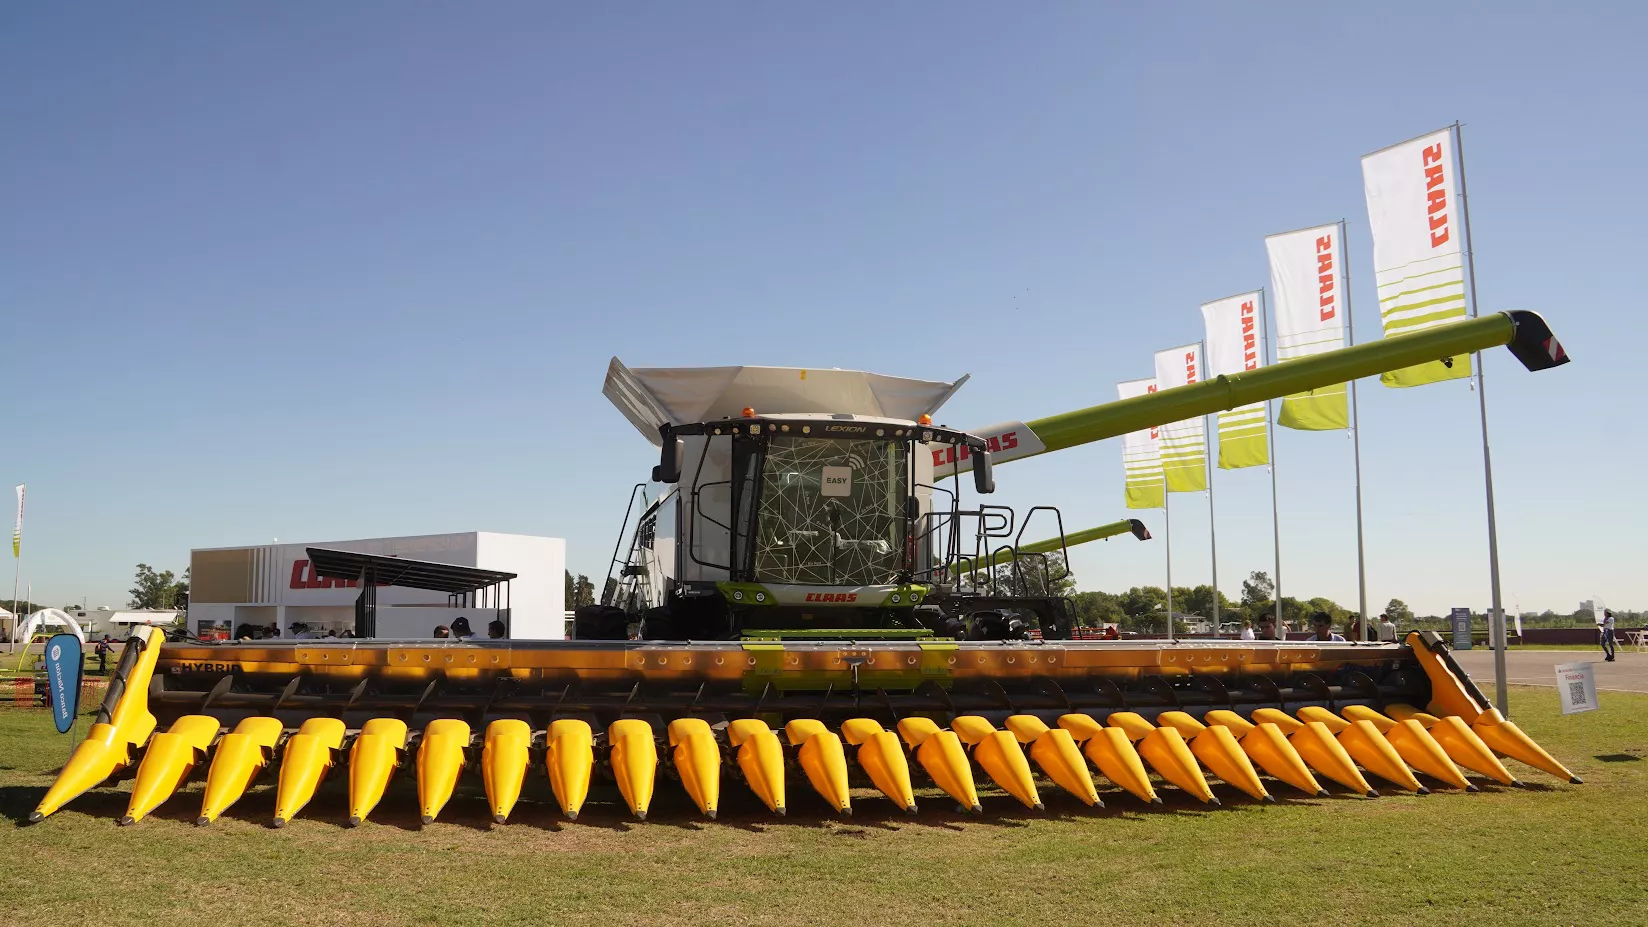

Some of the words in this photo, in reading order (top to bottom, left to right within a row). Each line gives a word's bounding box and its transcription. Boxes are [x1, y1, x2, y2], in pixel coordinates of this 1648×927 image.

[824, 425, 867, 433] LEXION
[826, 477, 848, 485] EASY
[805, 593, 857, 603] CLAAS
[181, 662, 243, 674] HYBRID
